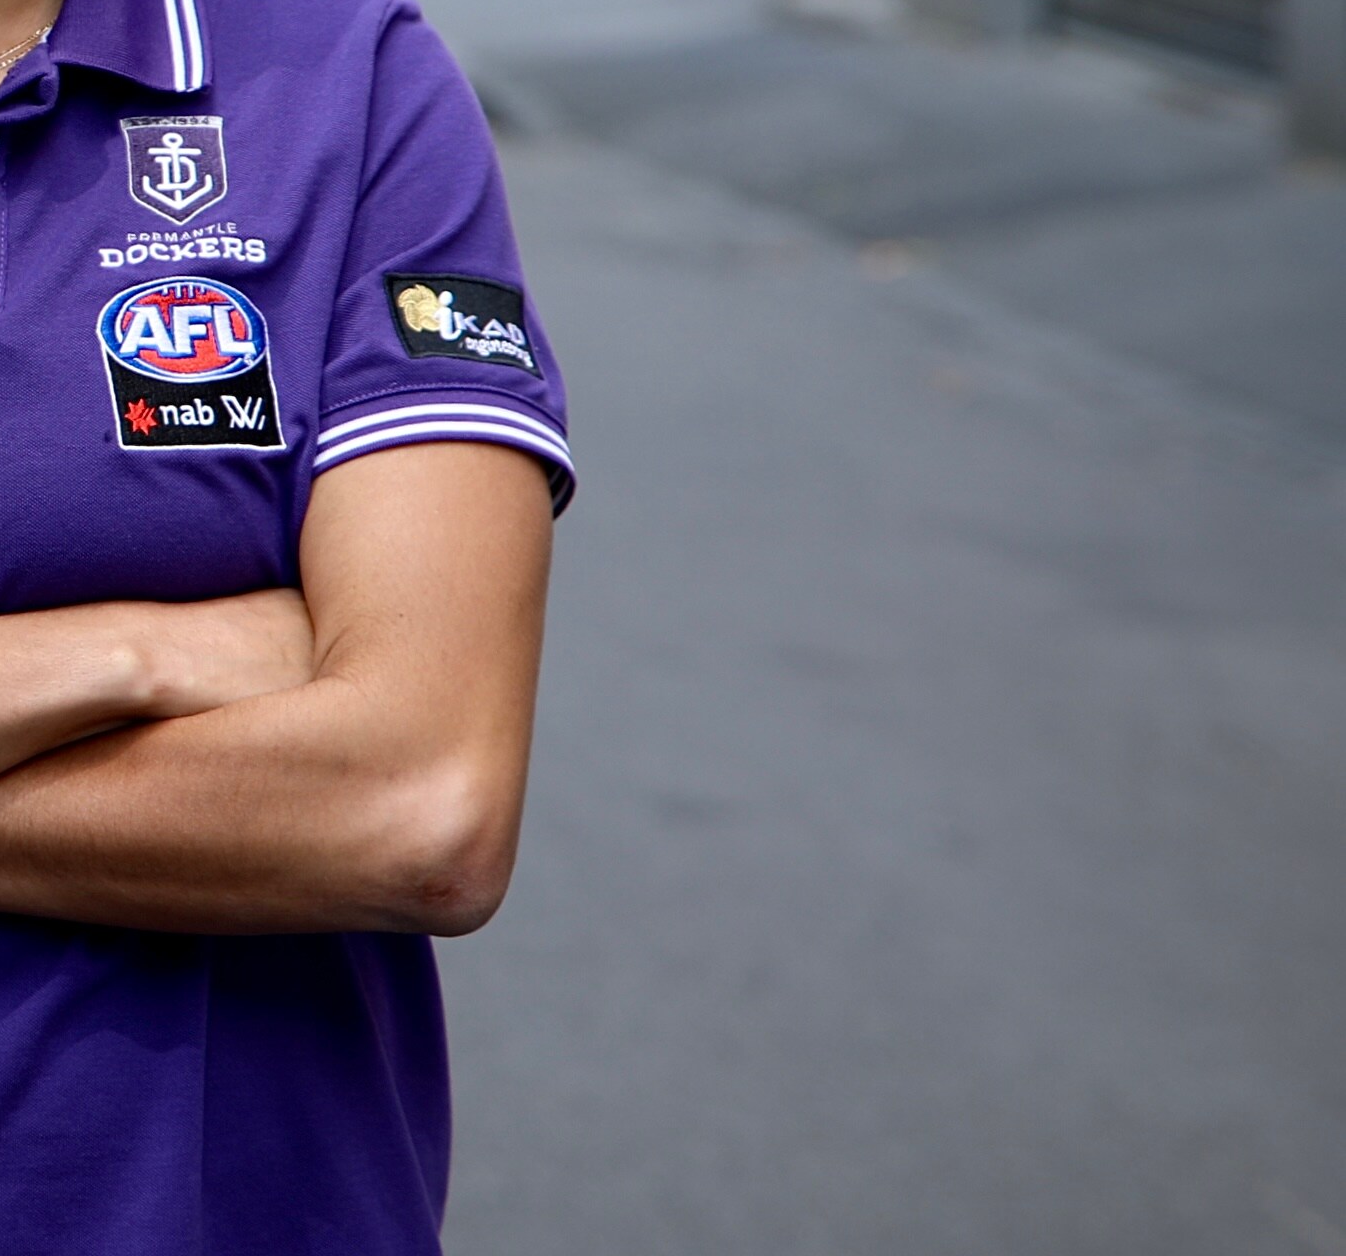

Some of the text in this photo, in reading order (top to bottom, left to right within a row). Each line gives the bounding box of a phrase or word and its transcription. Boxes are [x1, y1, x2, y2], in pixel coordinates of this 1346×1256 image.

[127, 222, 237, 242] FREMANTLE
[98, 238, 266, 268] DOCKERS
[119, 305, 257, 358] AFL
[159, 398, 214, 426] nab
